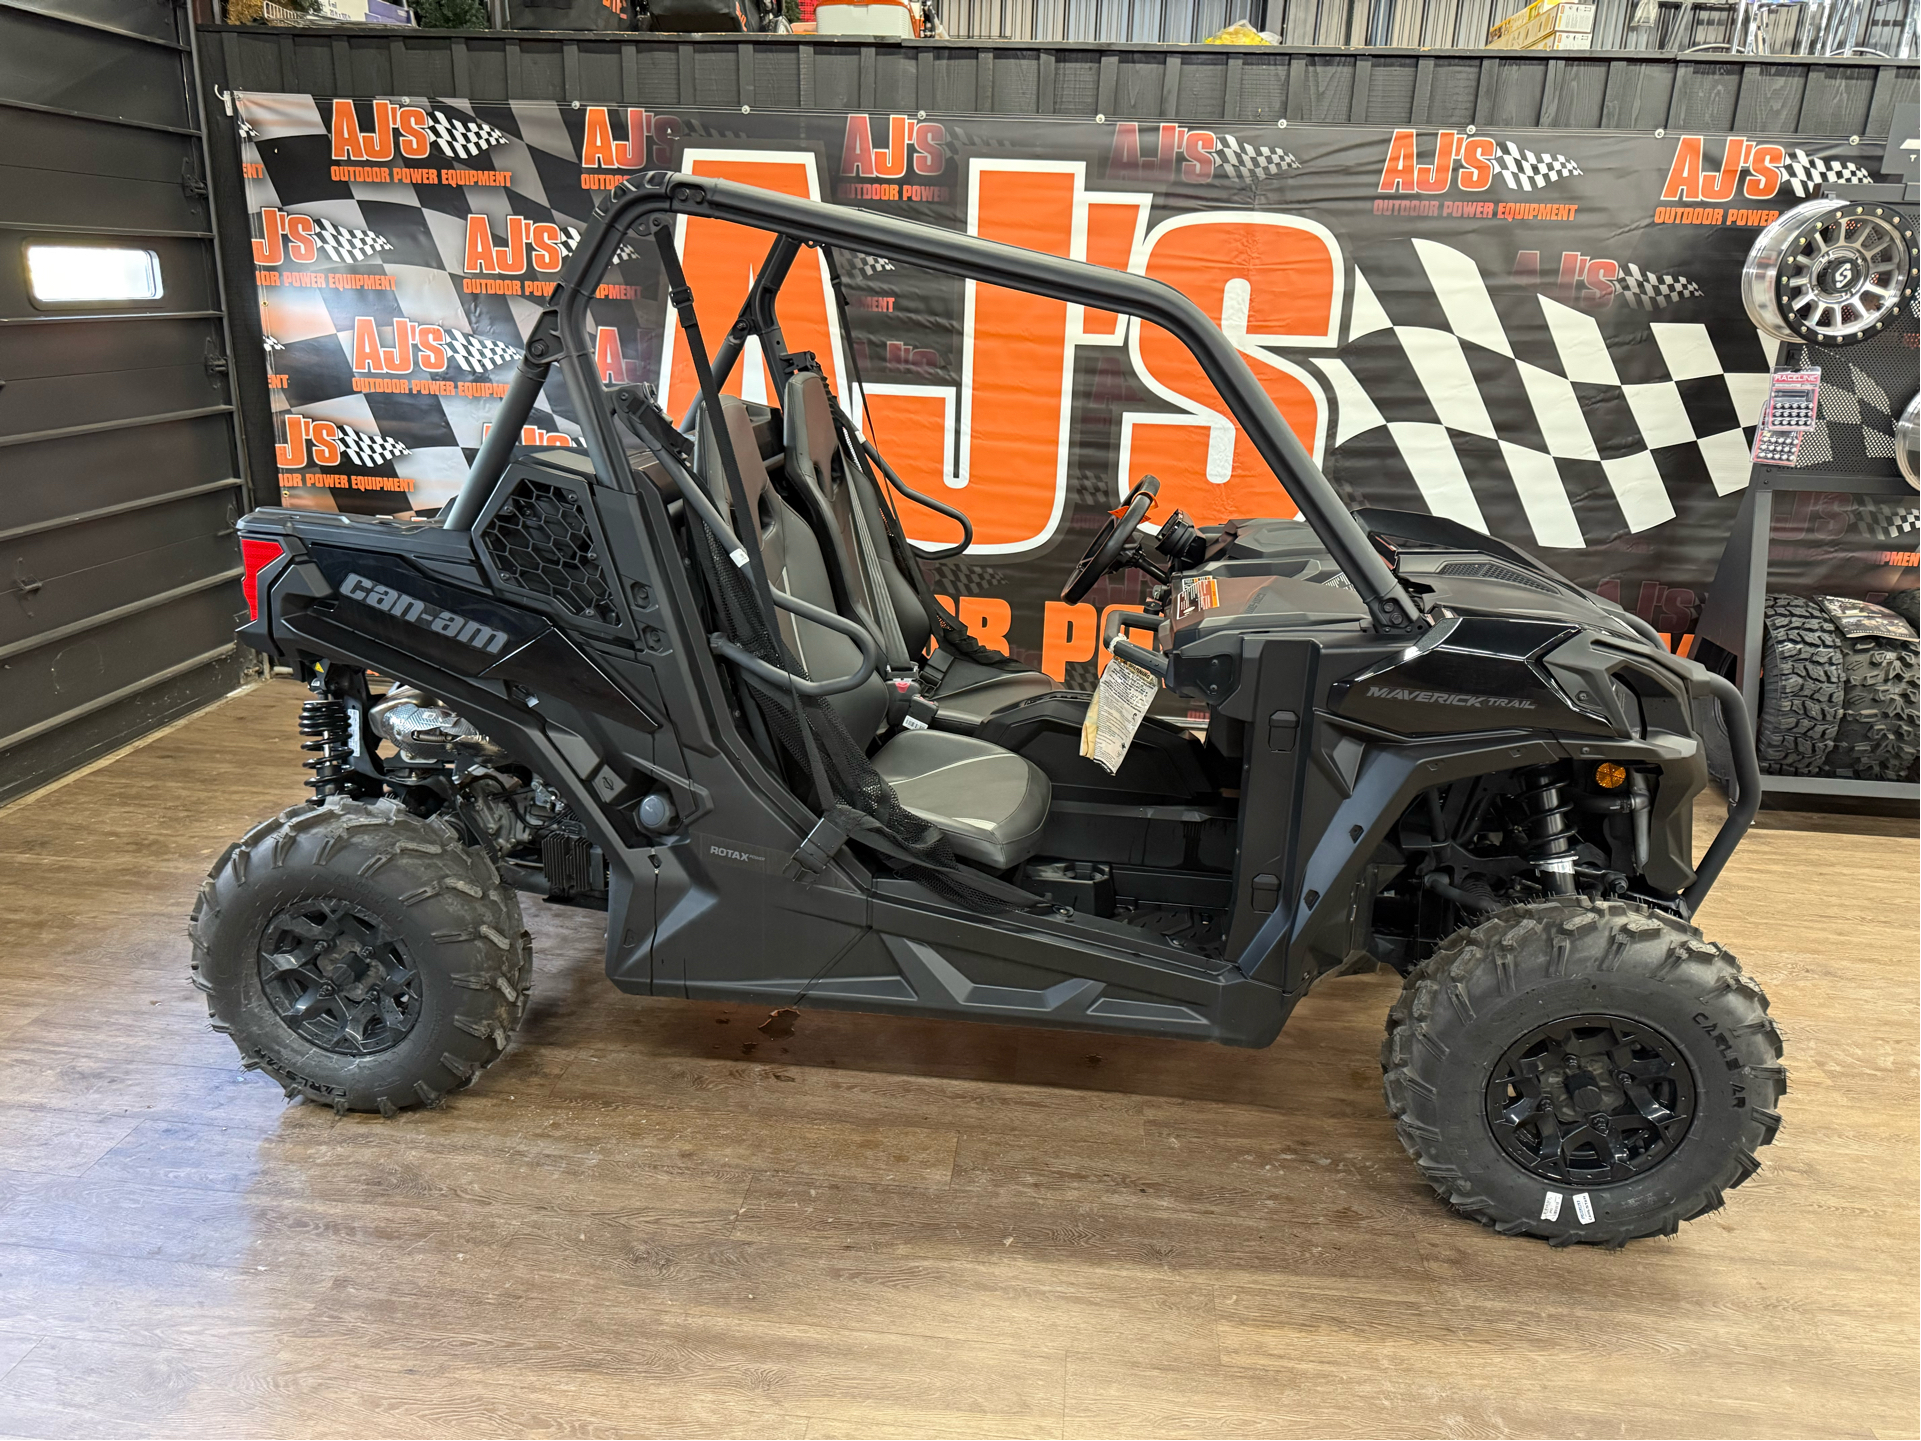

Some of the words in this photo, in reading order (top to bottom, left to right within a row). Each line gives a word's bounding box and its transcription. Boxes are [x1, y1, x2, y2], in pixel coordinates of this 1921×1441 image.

[331, 99, 430, 161] AJ'S
[840, 114, 945, 178] AJ'S
[1105, 122, 1216, 183] AJ'S
[1378, 129, 1496, 194] AJ'S
[1661, 135, 1785, 203] AJ'S
[331, 166, 390, 182] OUTDOOR
[393, 168, 438, 184] POWER
[441, 170, 512, 187] EQUIPMENT
[581, 174, 630, 190] OUTDO
[902, 185, 949, 202] POWER
[1373, 199, 1439, 217] OUTDOOR
[1443, 201, 1495, 219] POWER
[1497, 203, 1578, 222] EQUIPMENT
[1654, 206, 1724, 225] OUTDOOR
[1726, 209, 1780, 226] POWER
[464, 213, 564, 275] AJ'S
[283, 271, 326, 288] POWER
[328, 273, 396, 291] EQUIPMENT
[463, 278, 522, 295] OUTDOOR
[353, 316, 447, 374] AJ'S
[657, 147, 1345, 555] AJ'S
[352, 377, 409, 394] OUTDOOR
[412, 380, 456, 396] POWER
[457, 382, 510, 399] EQUIPM
[306, 473, 349, 488] POWER
[351, 475, 415, 492] EQUIPMENT
[338, 572, 510, 654] can-am
[1366, 686, 1484, 708] MAVERICK
[1487, 697, 1538, 709] TRAIL
[710, 845, 750, 862] ROTAX
